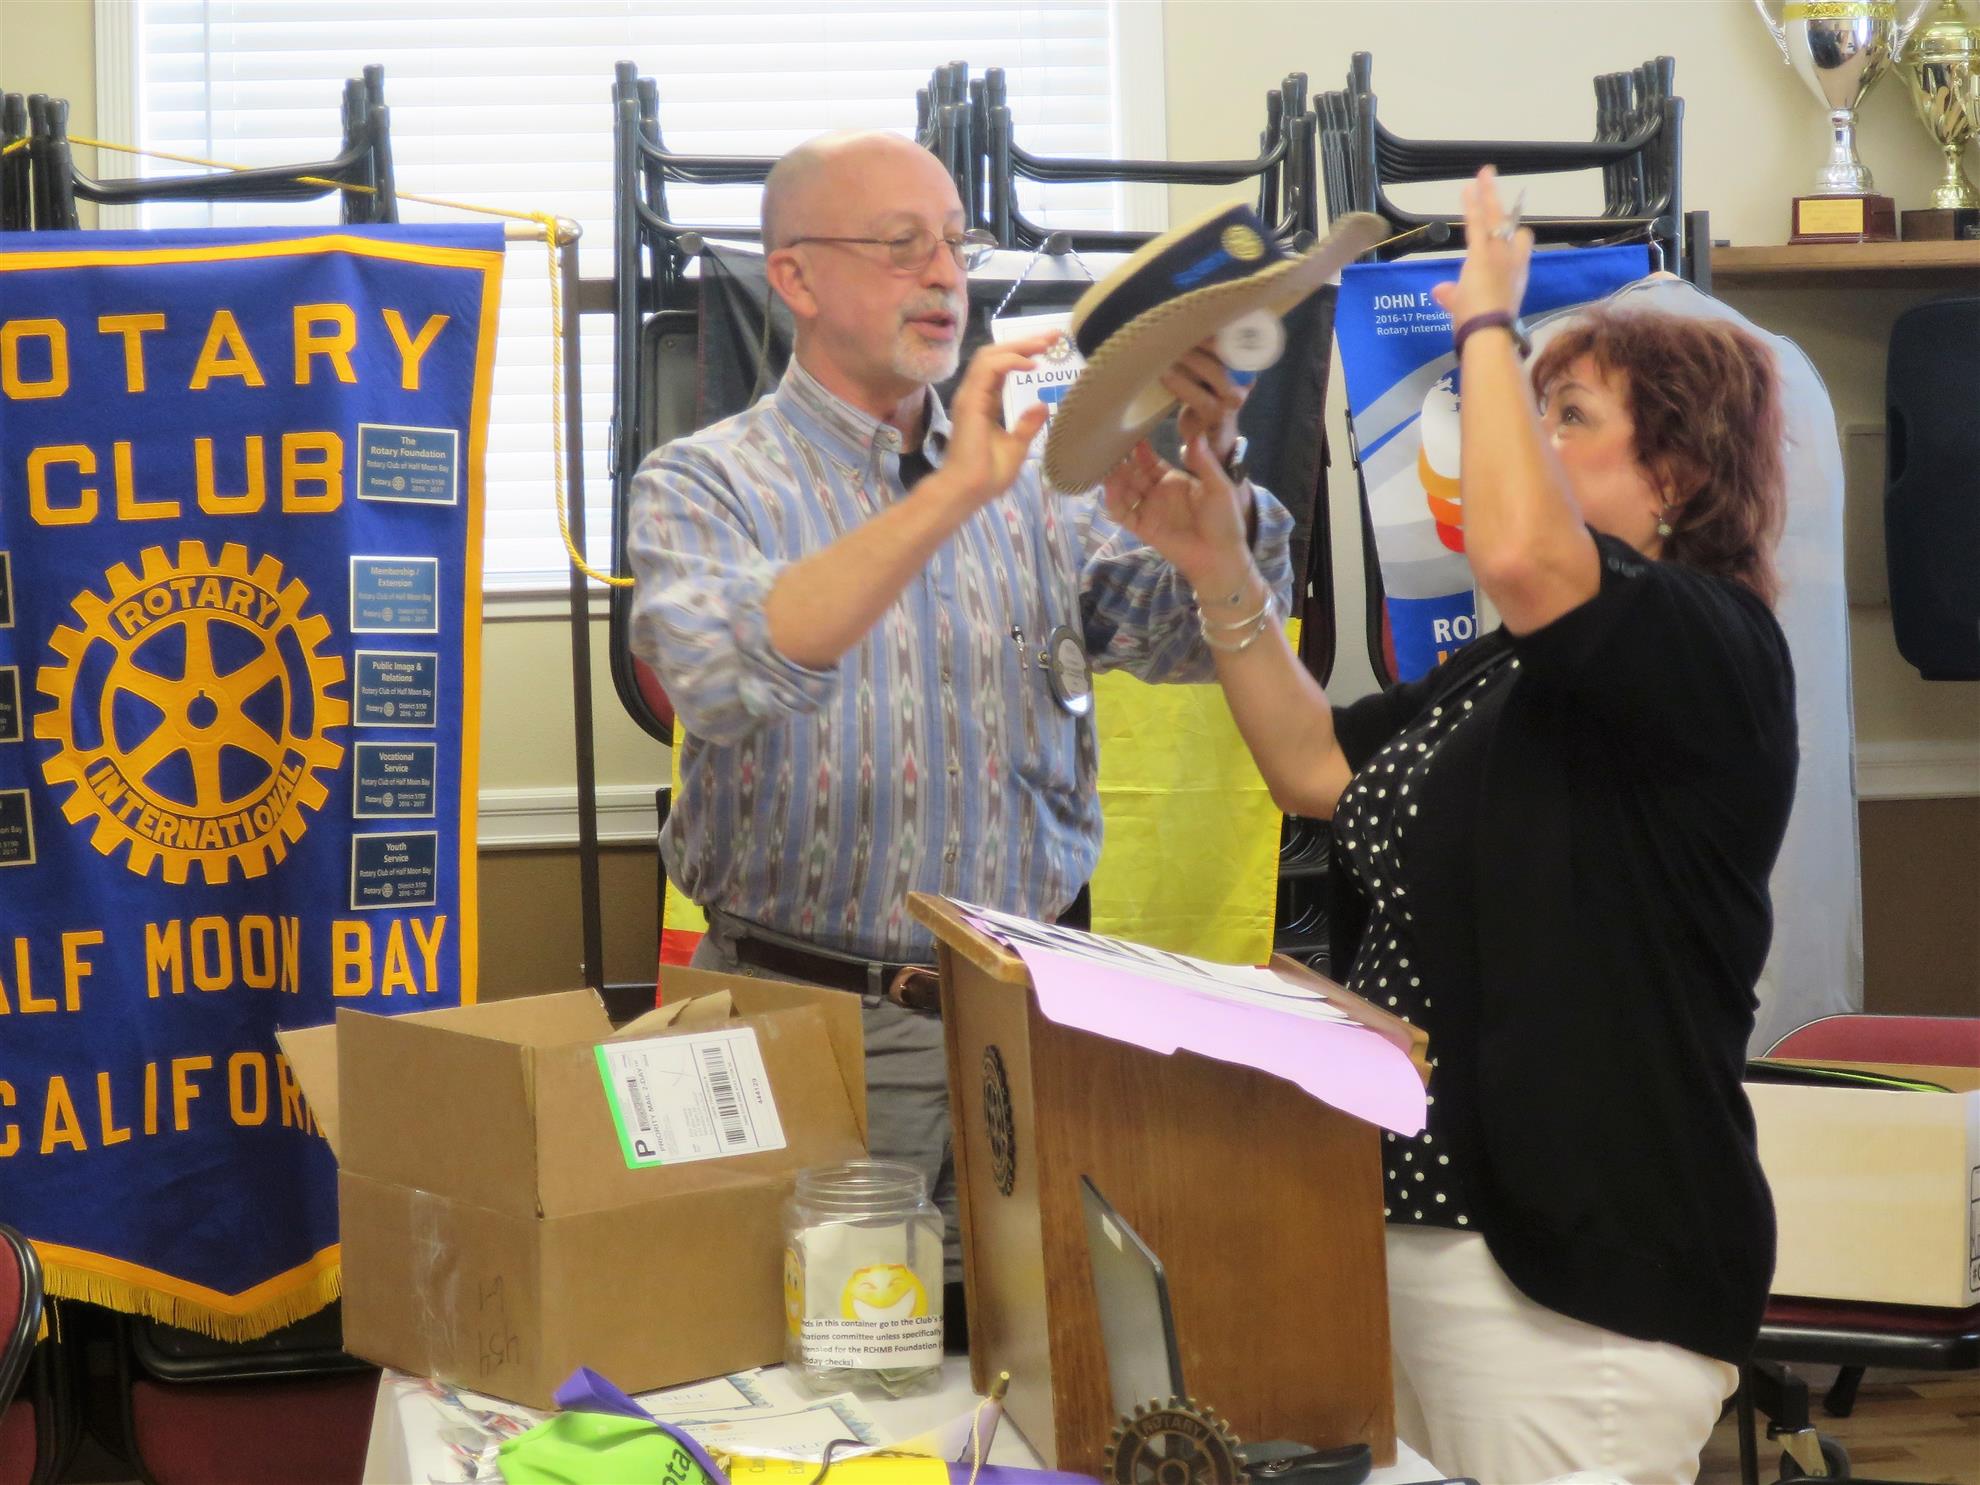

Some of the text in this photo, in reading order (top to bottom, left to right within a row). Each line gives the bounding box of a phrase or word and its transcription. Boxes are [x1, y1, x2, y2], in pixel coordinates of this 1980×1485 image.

[1374, 292, 1432, 310] JOHN F.
[1376, 313, 1413, 324] 2016-17
[1376, 326, 1408, 336] Rotary
[0, 304, 450, 399] OTARY
[1016, 369, 1082, 385] LA LOUVI
[401, 436, 416, 446] The
[370, 446, 446, 458] Rotary Foundation
[27, 431, 345, 526] CLUB
[370, 478, 392, 486] Rotary
[370, 567, 416, 577] Membership
[114, 577, 278, 636] ROTARY
[1433, 615, 1476, 644] RO
[373, 662, 392, 670] Public
[394, 662, 414, 672] Image
[382, 673, 412, 682] Relations
[362, 687, 378, 696] Rotary
[366, 704, 383, 712] Rotary
[379, 752, 414, 760] Vocational
[384, 764, 408, 772] Service
[365, 796, 382, 804] Rotary
[88, 762, 303, 850] INTERNATIONAL
[386, 842, 406, 851] Youth
[384, 854, 408, 862] Service
[360, 870, 376, 878] Rotary
[0, 915, 448, 1015] LF MOON BAY
[0, 1052, 327, 1157] CALIFOR
[644, 1094, 654, 1112] MAIL
[652, 1114, 666, 1152] PRIORITY
[635, 1140, 656, 1158] P
[816, 1319, 823, 1327] in
[825, 1319, 839, 1327] this
[841, 1320, 877, 1328] container
[879, 1321, 890, 1329] go
[891, 1319, 900, 1327] to
[900, 1318, 914, 1326] the
[915, 1316, 938, 1325] Club's
[832, 1332, 874, 1340] committee
[876, 1332, 900, 1341] unless
[902, 1329, 941, 1340] specifically
[894, 1342, 937, 1352] Foundation
[825, 1358, 854, 1368] checks)
[1142, 1414, 1202, 1438] ROTARY
